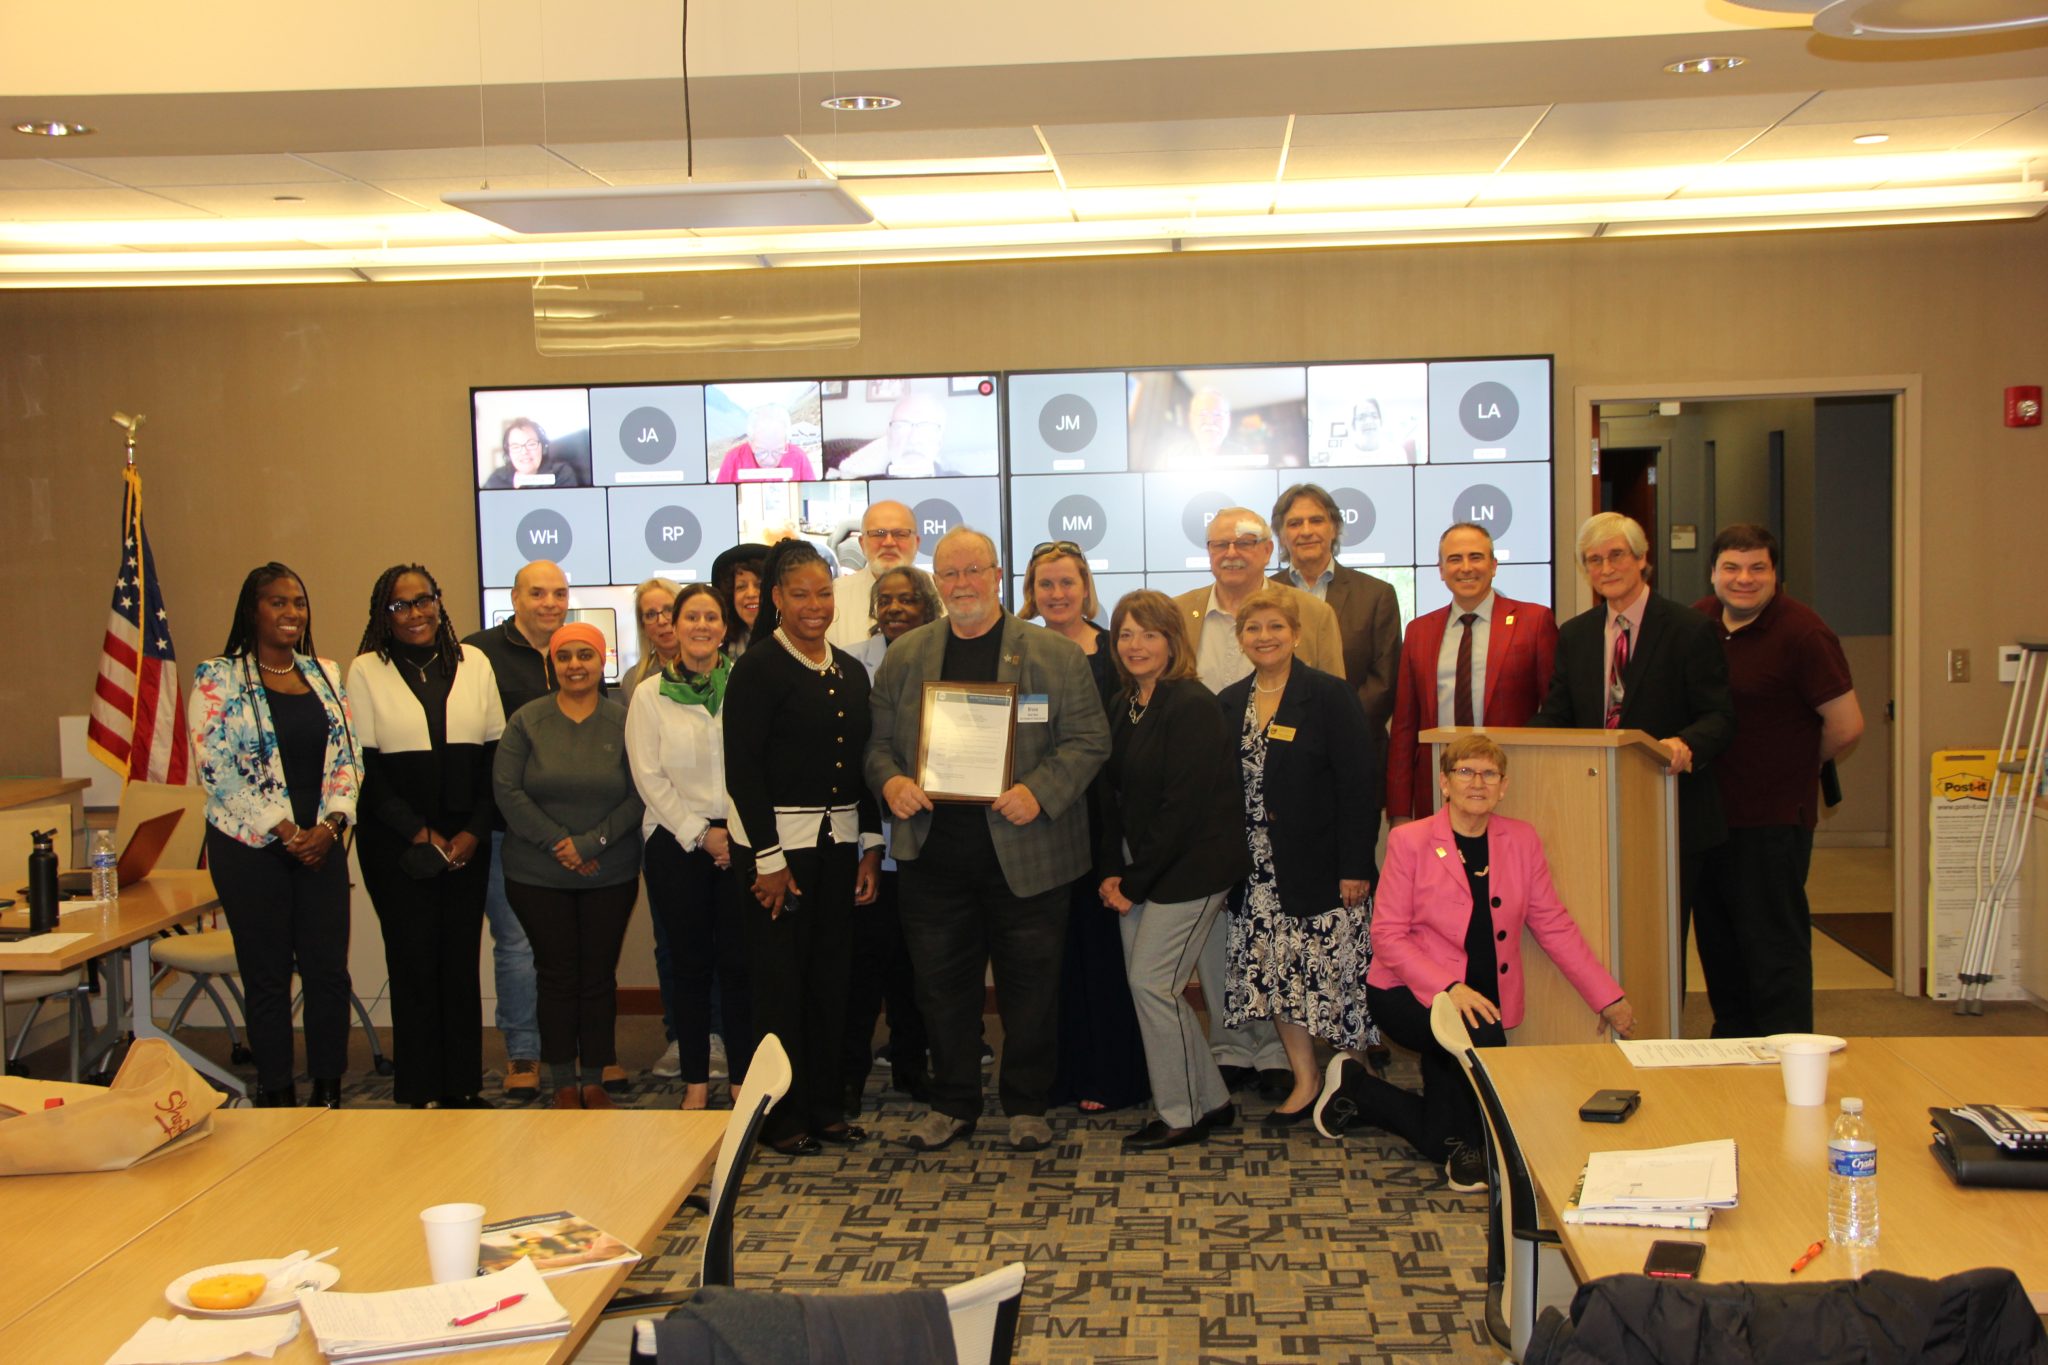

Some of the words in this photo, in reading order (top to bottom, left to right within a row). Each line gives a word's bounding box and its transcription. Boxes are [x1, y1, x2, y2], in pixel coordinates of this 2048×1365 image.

[1478, 403, 1501, 419] LA
[1055, 414, 1080, 431] JM
[637, 427, 659, 443] JA
[1471, 505, 1494, 521] LN
[923, 519, 947, 535] RH
[1062, 515, 1093, 531] MM
[529, 529, 558, 545] WH
[662, 526, 685, 542] RP
[1944, 781, 1987, 793] Post-it
